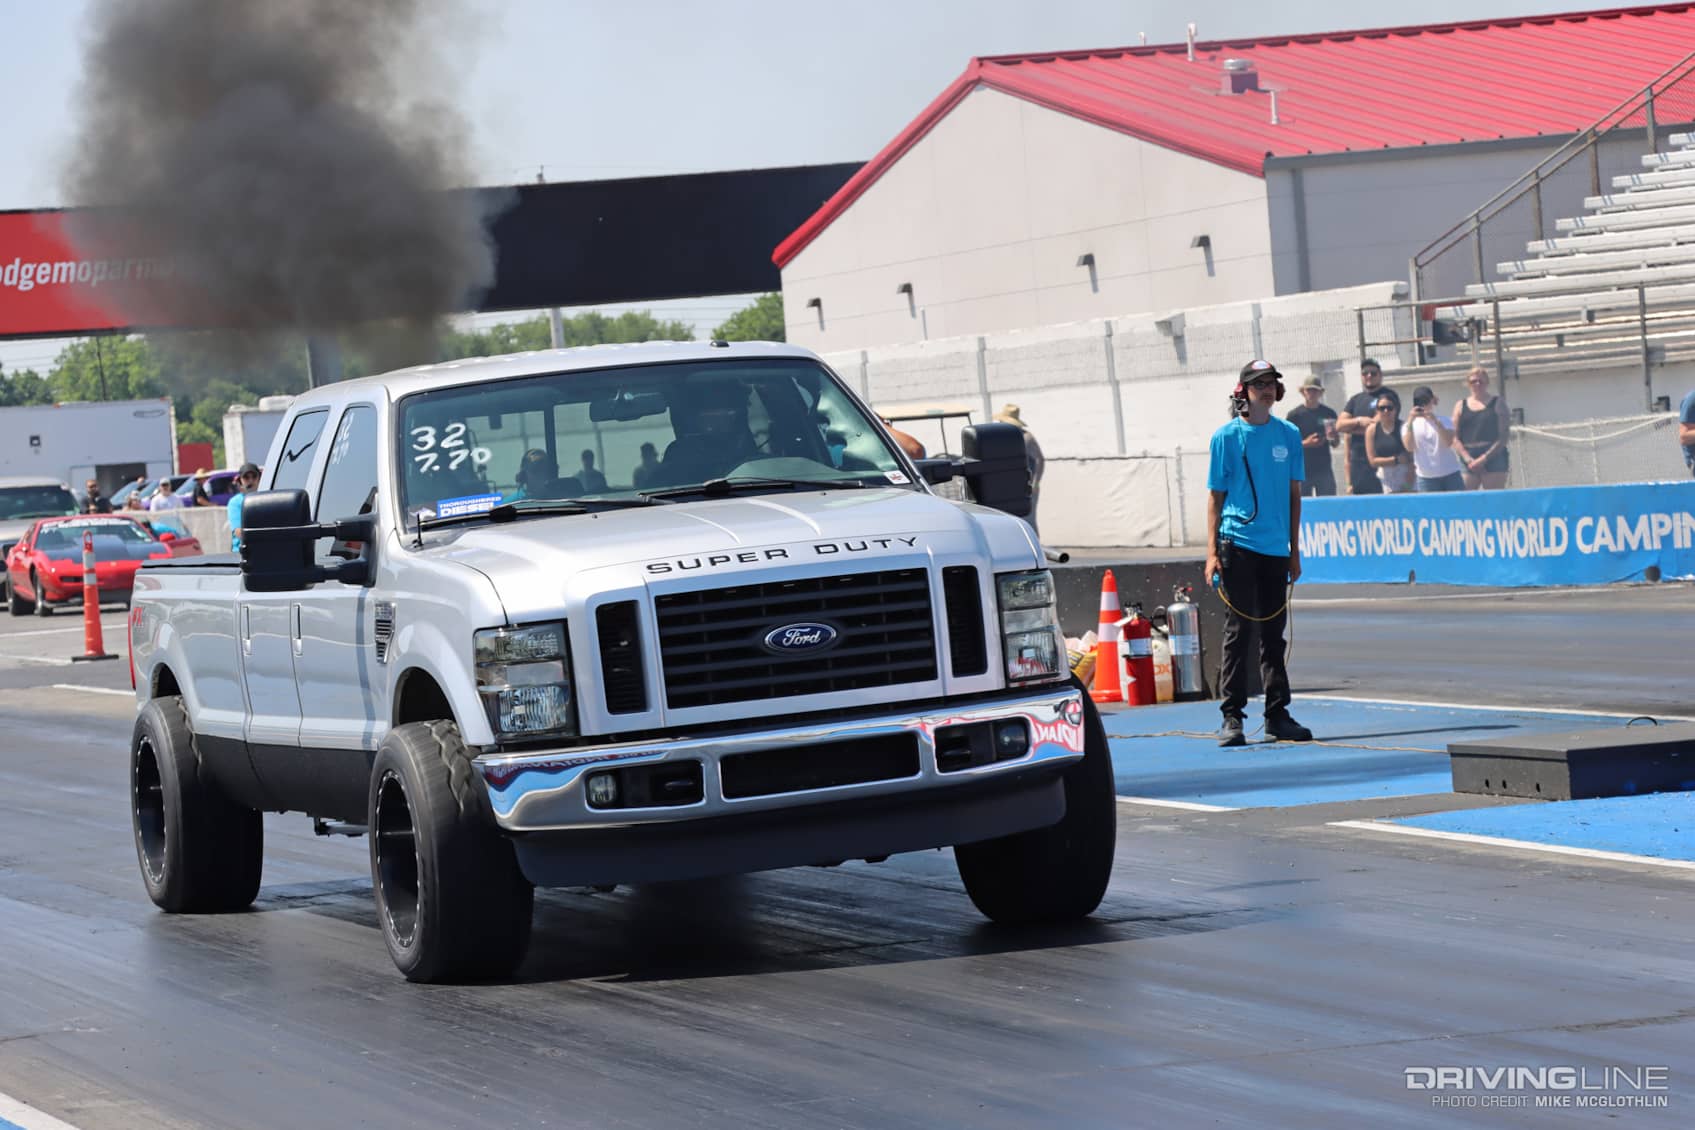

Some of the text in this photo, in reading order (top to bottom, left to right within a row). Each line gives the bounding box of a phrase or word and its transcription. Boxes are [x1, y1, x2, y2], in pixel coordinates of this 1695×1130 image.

[410, 422, 466, 451] 32
[414, 447, 492, 473] 7.70
[1298, 512, 1695, 558] AMPING WORLD CAMPING WORLD CAMPIN
[646, 536, 918, 574] SUPER DUTY
[781, 627, 821, 647] Ford
